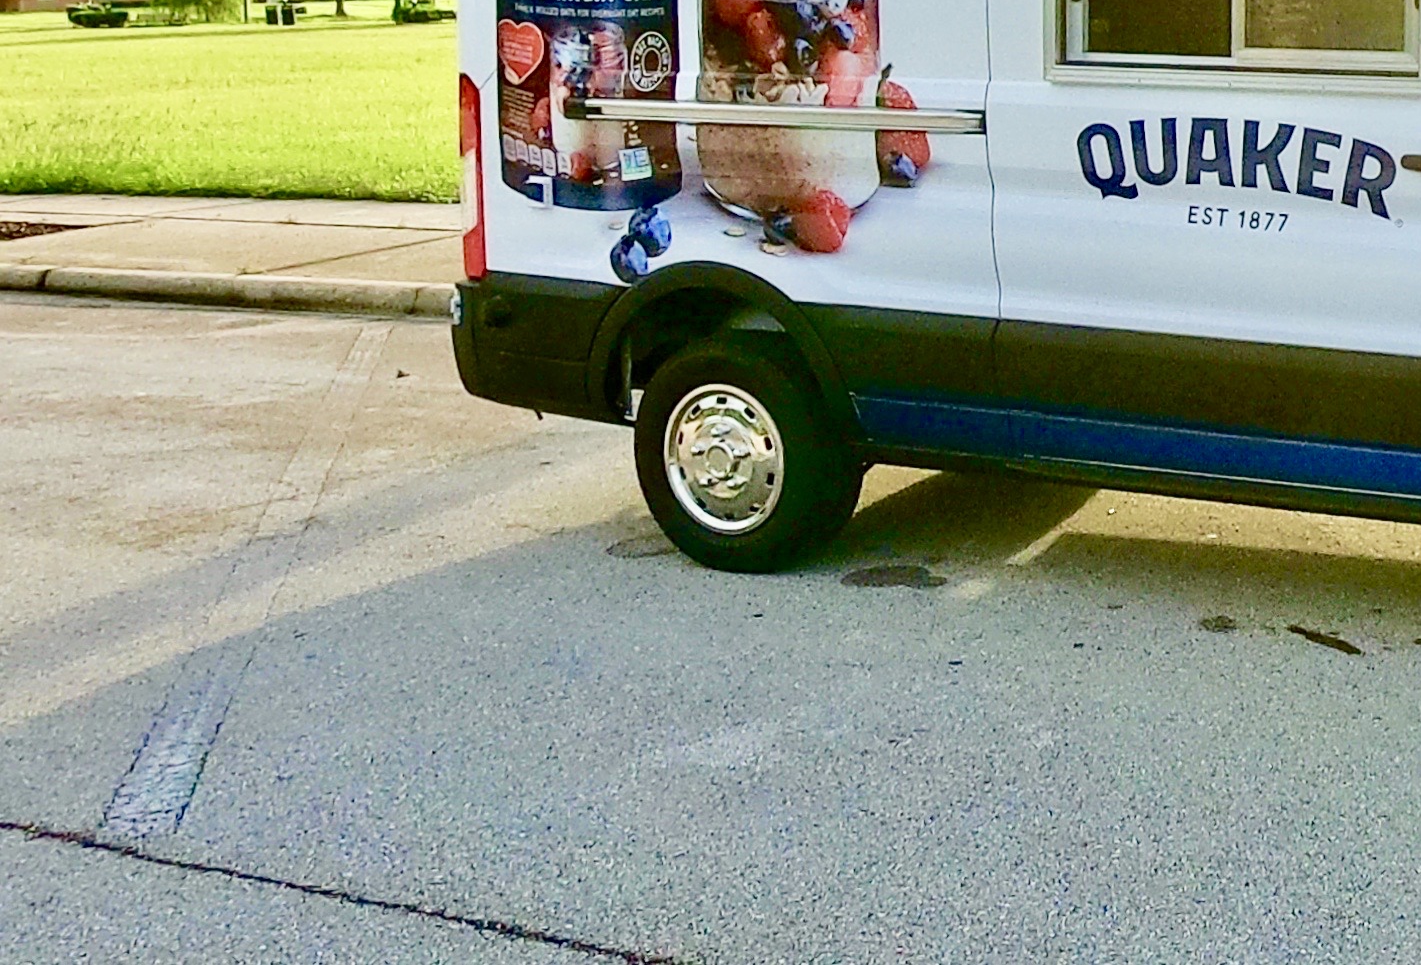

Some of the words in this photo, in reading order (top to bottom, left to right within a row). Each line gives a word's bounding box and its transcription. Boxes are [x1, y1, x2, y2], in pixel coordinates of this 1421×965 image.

[1077, 117, 1397, 220] QUAKER
[1187, 206, 1229, 227] EST
[1239, 210, 1289, 232] 1877
